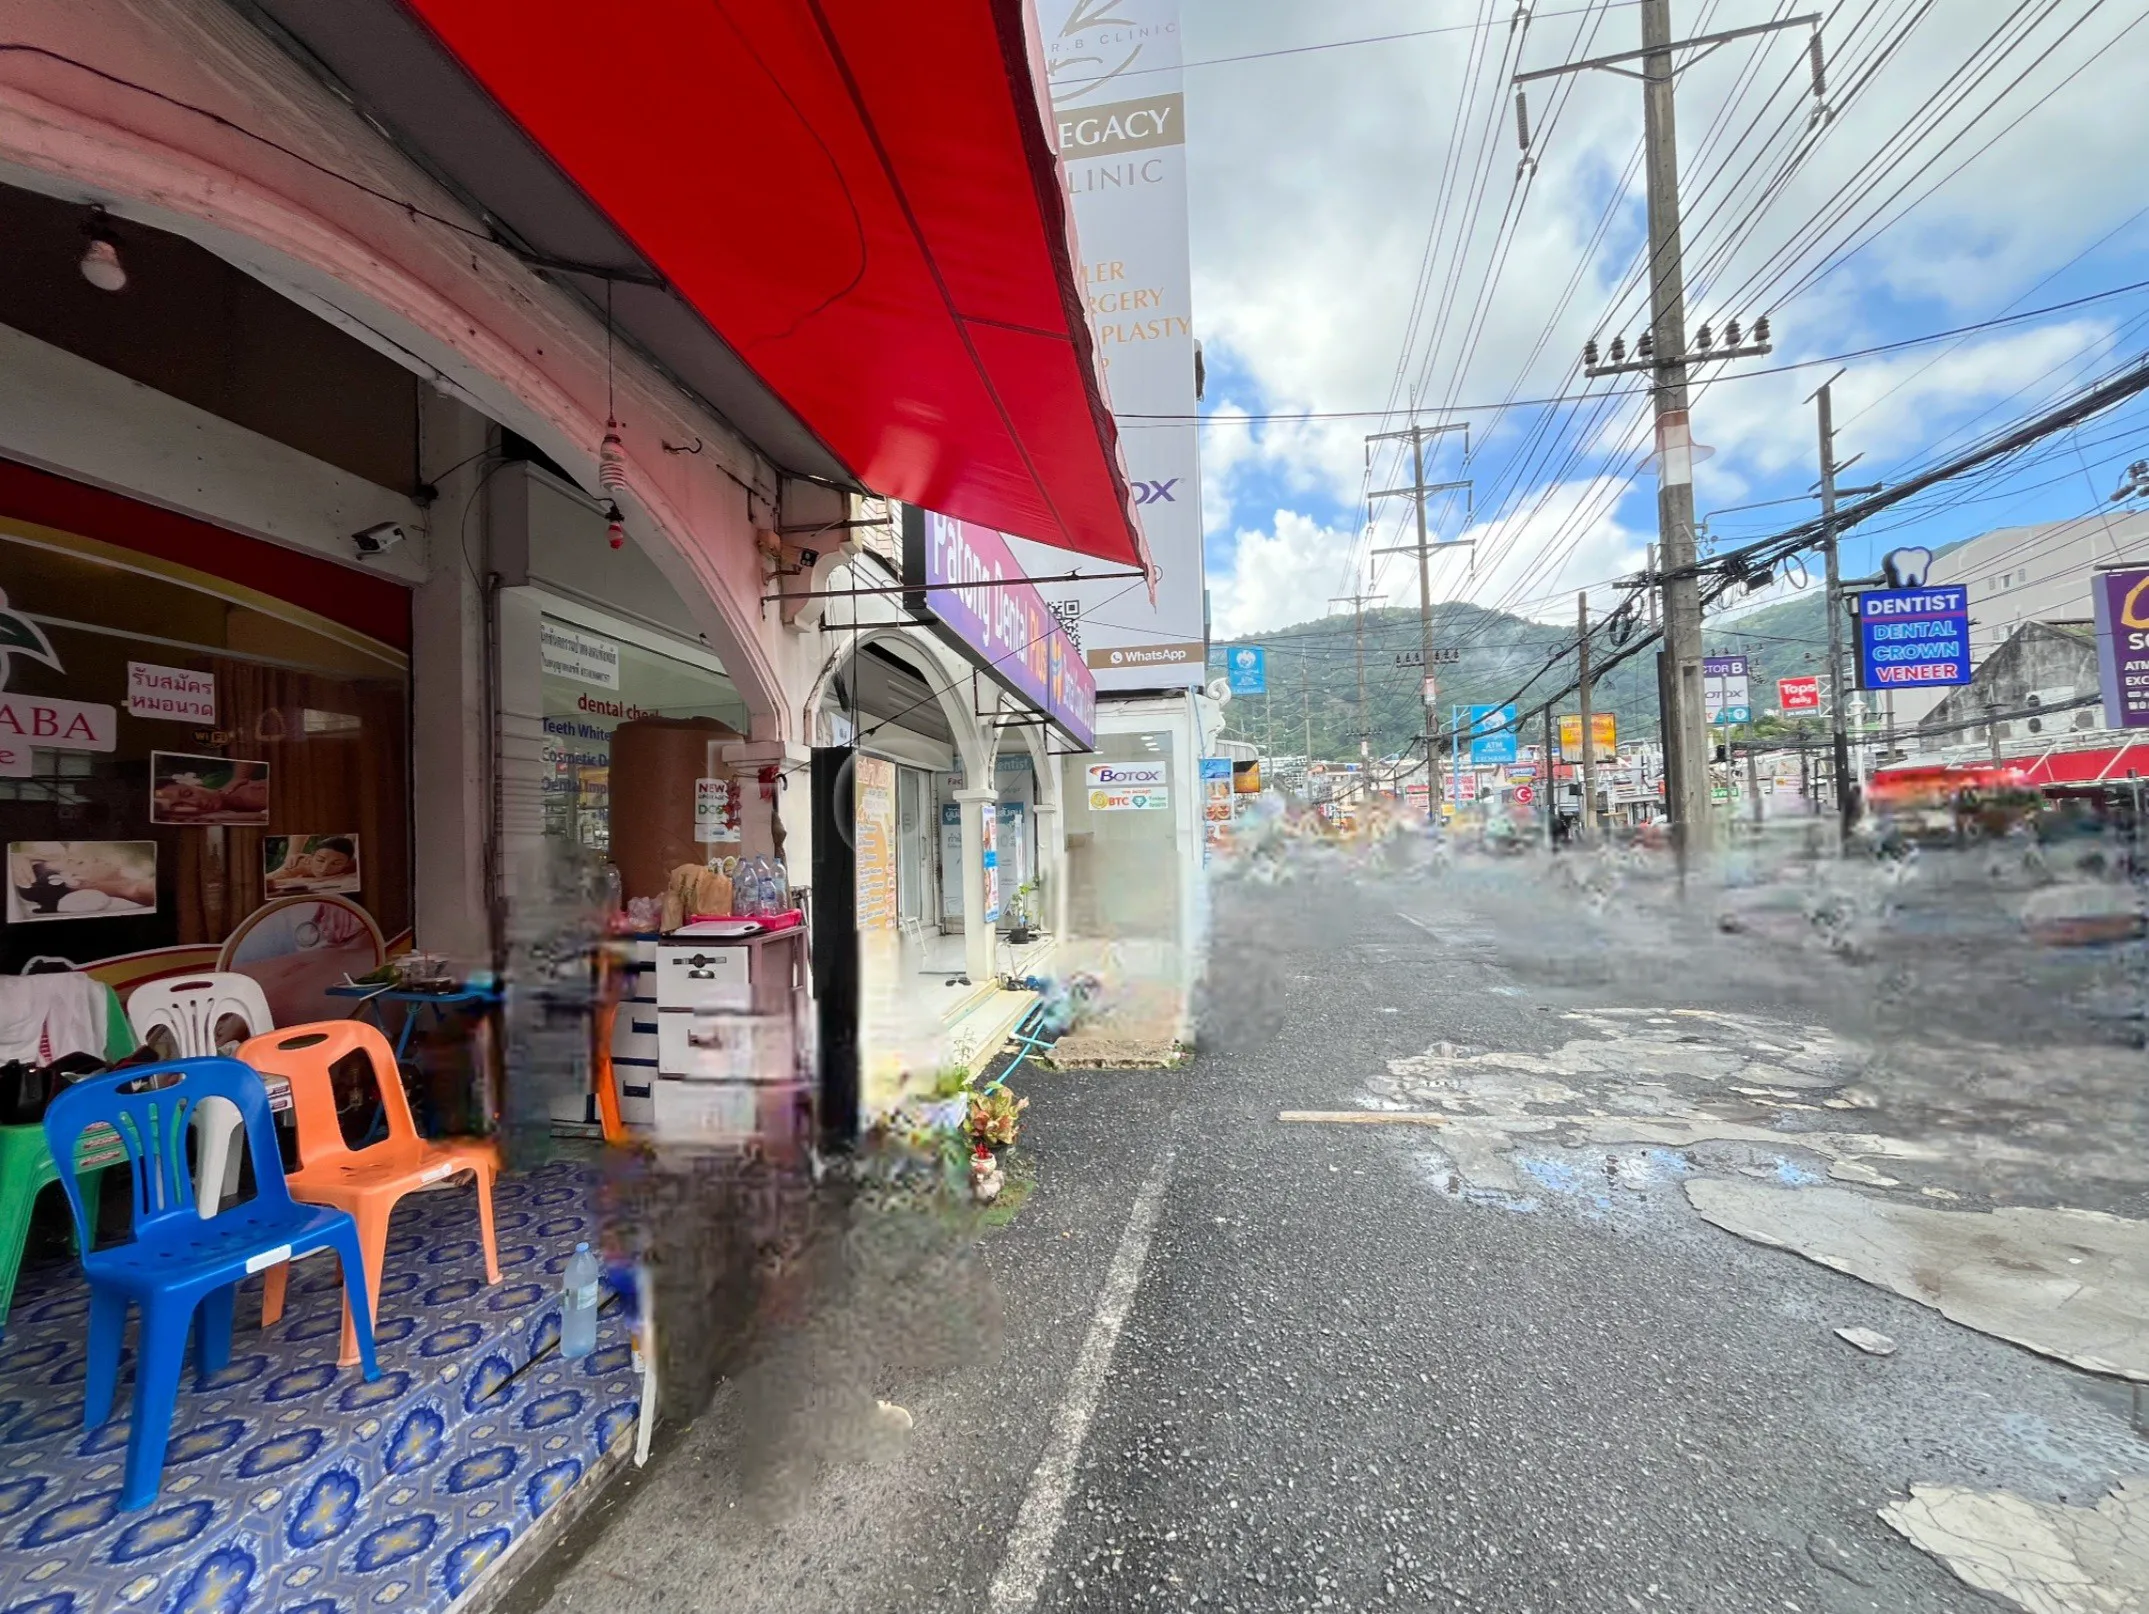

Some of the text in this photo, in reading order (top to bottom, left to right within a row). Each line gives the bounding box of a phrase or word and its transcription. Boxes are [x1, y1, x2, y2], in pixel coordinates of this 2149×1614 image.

[1100, 22, 1176, 45] CLINIC
[1101, 315, 1191, 345] PLASTY
[933, 511, 990, 648] Patong
[994, 560, 1028, 666] Dental
[1866, 594, 1960, 615] DENTIST
[1873, 620, 1957, 640] DENTAL
[2128, 632, 2149, 650] S
[1126, 649, 1187, 666] WhatsApp
[1872, 641, 1960, 661] CROWN
[1731, 662, 1743, 674] B
[1875, 663, 1958, 682] VENEER
[1782, 683, 1816, 695] Tops
[578, 692, 623, 719] dental
[1788, 696, 1812, 704] daily
[541, 717, 575, 737] Teeth
[541, 747, 597, 767] Cosmetic
[541, 776, 582, 793] Dental
[699, 783, 724, 793] NEW
[1108, 796, 1130, 806] BTC
